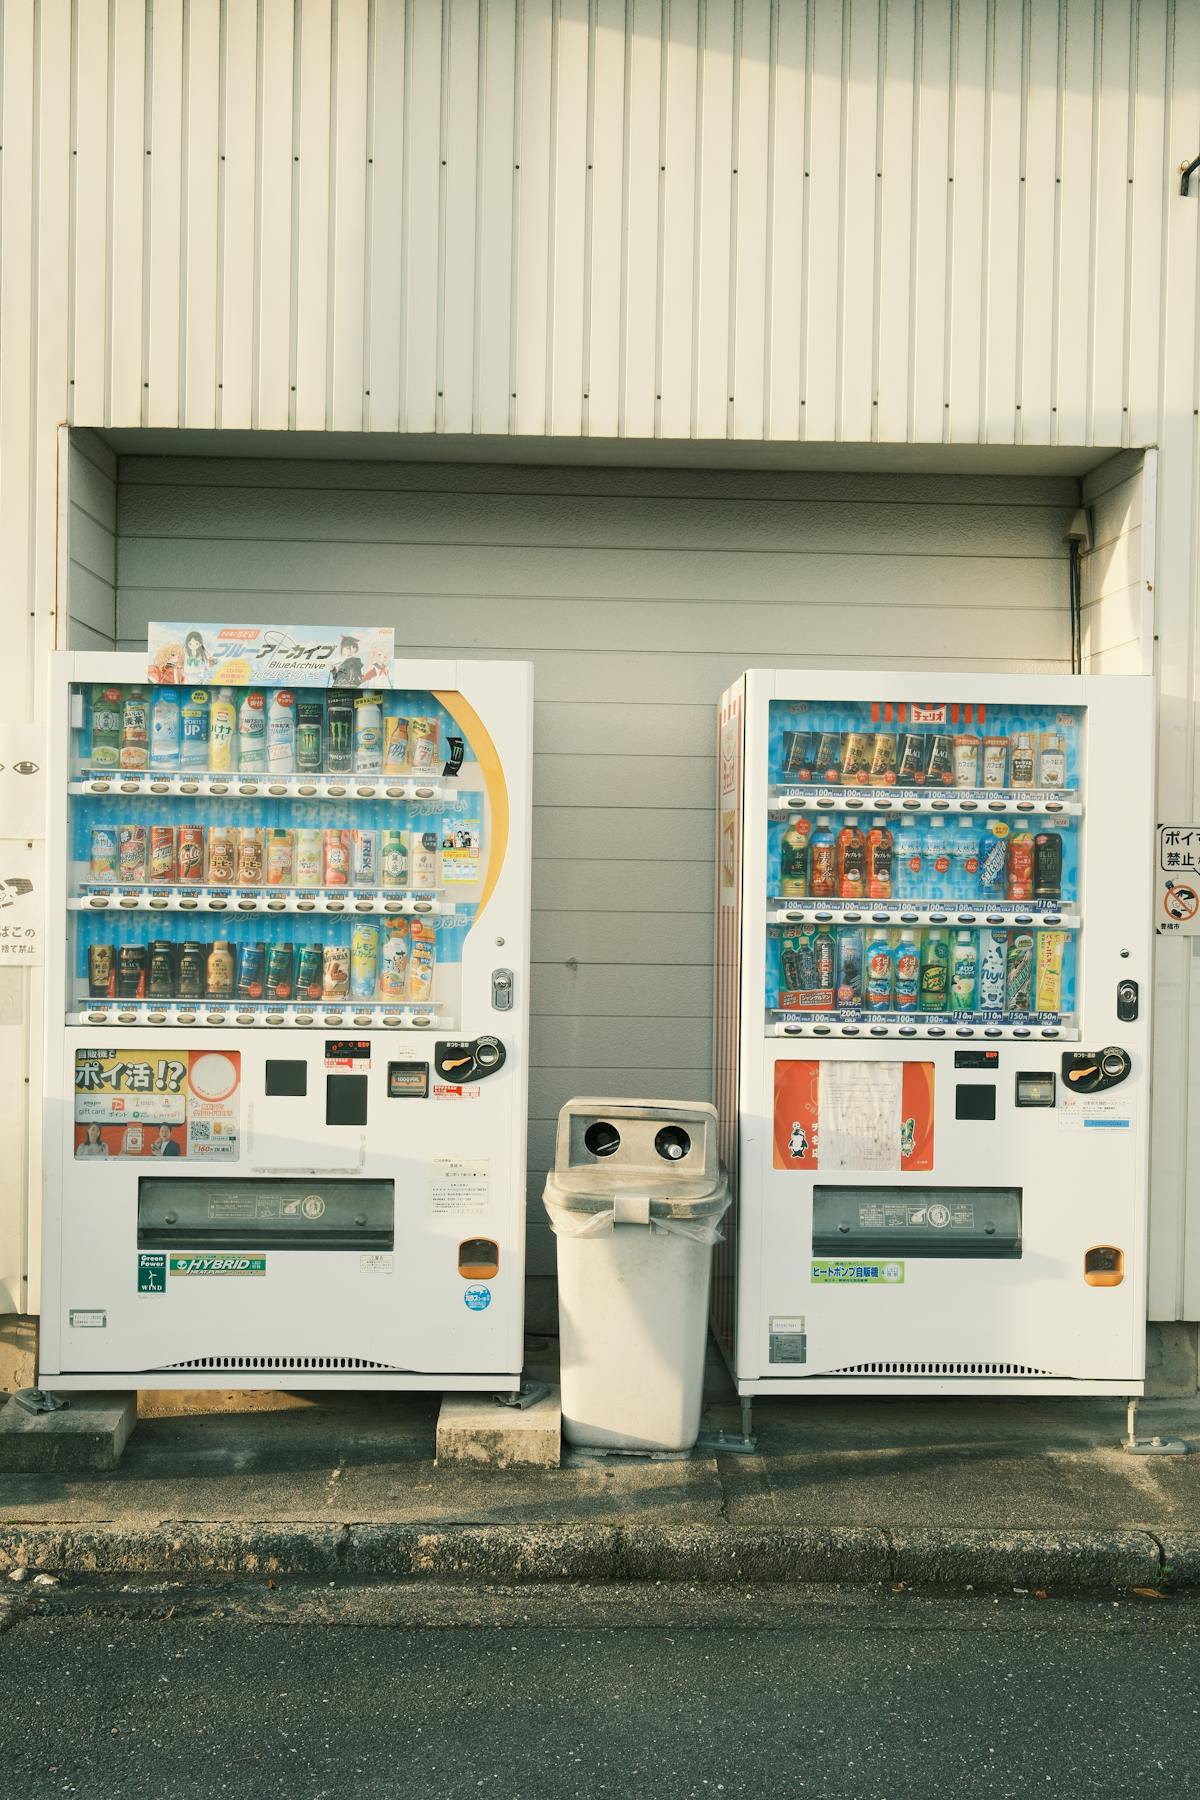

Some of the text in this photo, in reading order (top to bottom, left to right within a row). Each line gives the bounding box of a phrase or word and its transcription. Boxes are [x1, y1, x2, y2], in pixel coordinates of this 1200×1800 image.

[212, 642, 338, 660] ブルーアーカイブ
[914, 711, 943, 721] チェリオ
[183, 725, 200, 736] UP
[363, 840, 371, 868] FRISK
[1167, 852, 1194, 866] 禁止
[819, 852, 832, 881] 麦茶
[953, 1011, 972, 1020] 110円
[983, 1012, 1001, 1020] 110円
[1009, 1012, 1028, 1020] 150円
[1038, 1012, 1057, 1021] 150円
[187, 1259, 250, 1272] HYBRID
[813, 1267, 878, 1277] ヒートポンプ自販機
